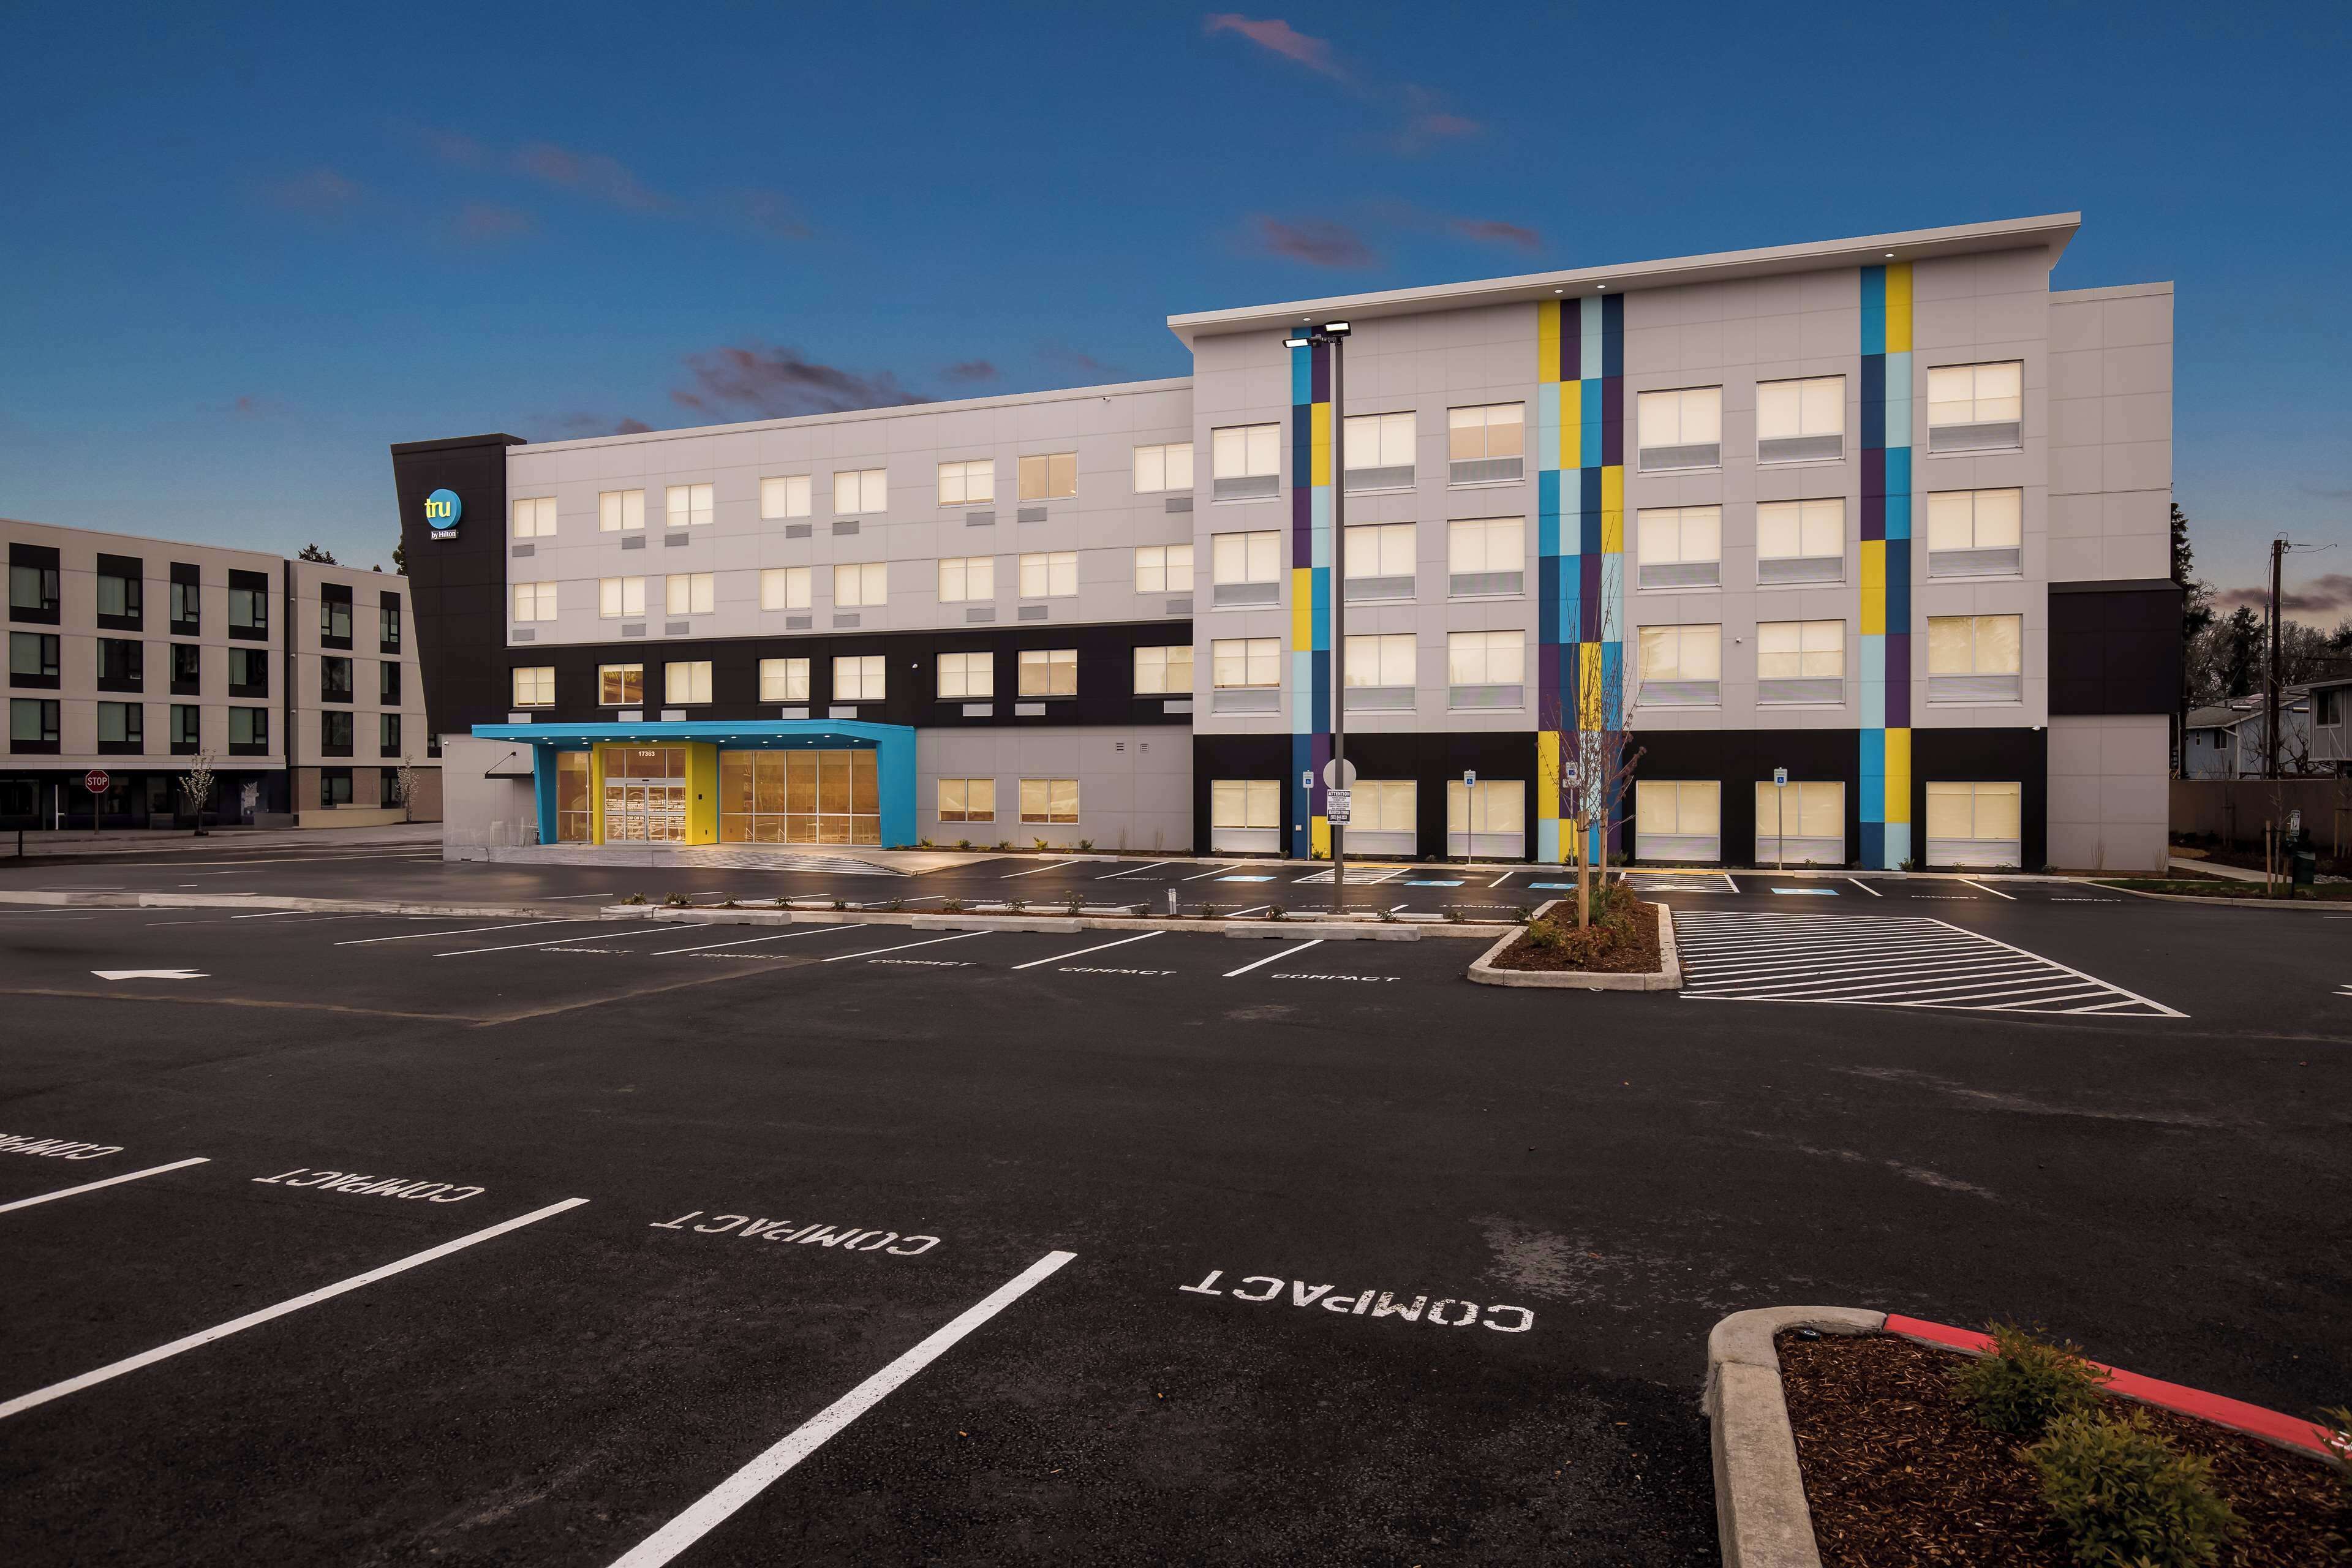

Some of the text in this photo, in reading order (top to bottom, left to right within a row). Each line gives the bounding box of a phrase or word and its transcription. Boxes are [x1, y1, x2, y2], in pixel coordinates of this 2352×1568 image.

[424, 499, 451, 518] tru
[251, 1168, 485, 1202] COMPACT
[649, 1211, 941, 1256] COMPACT
[1179, 1270, 1534, 1333] COMPACT
